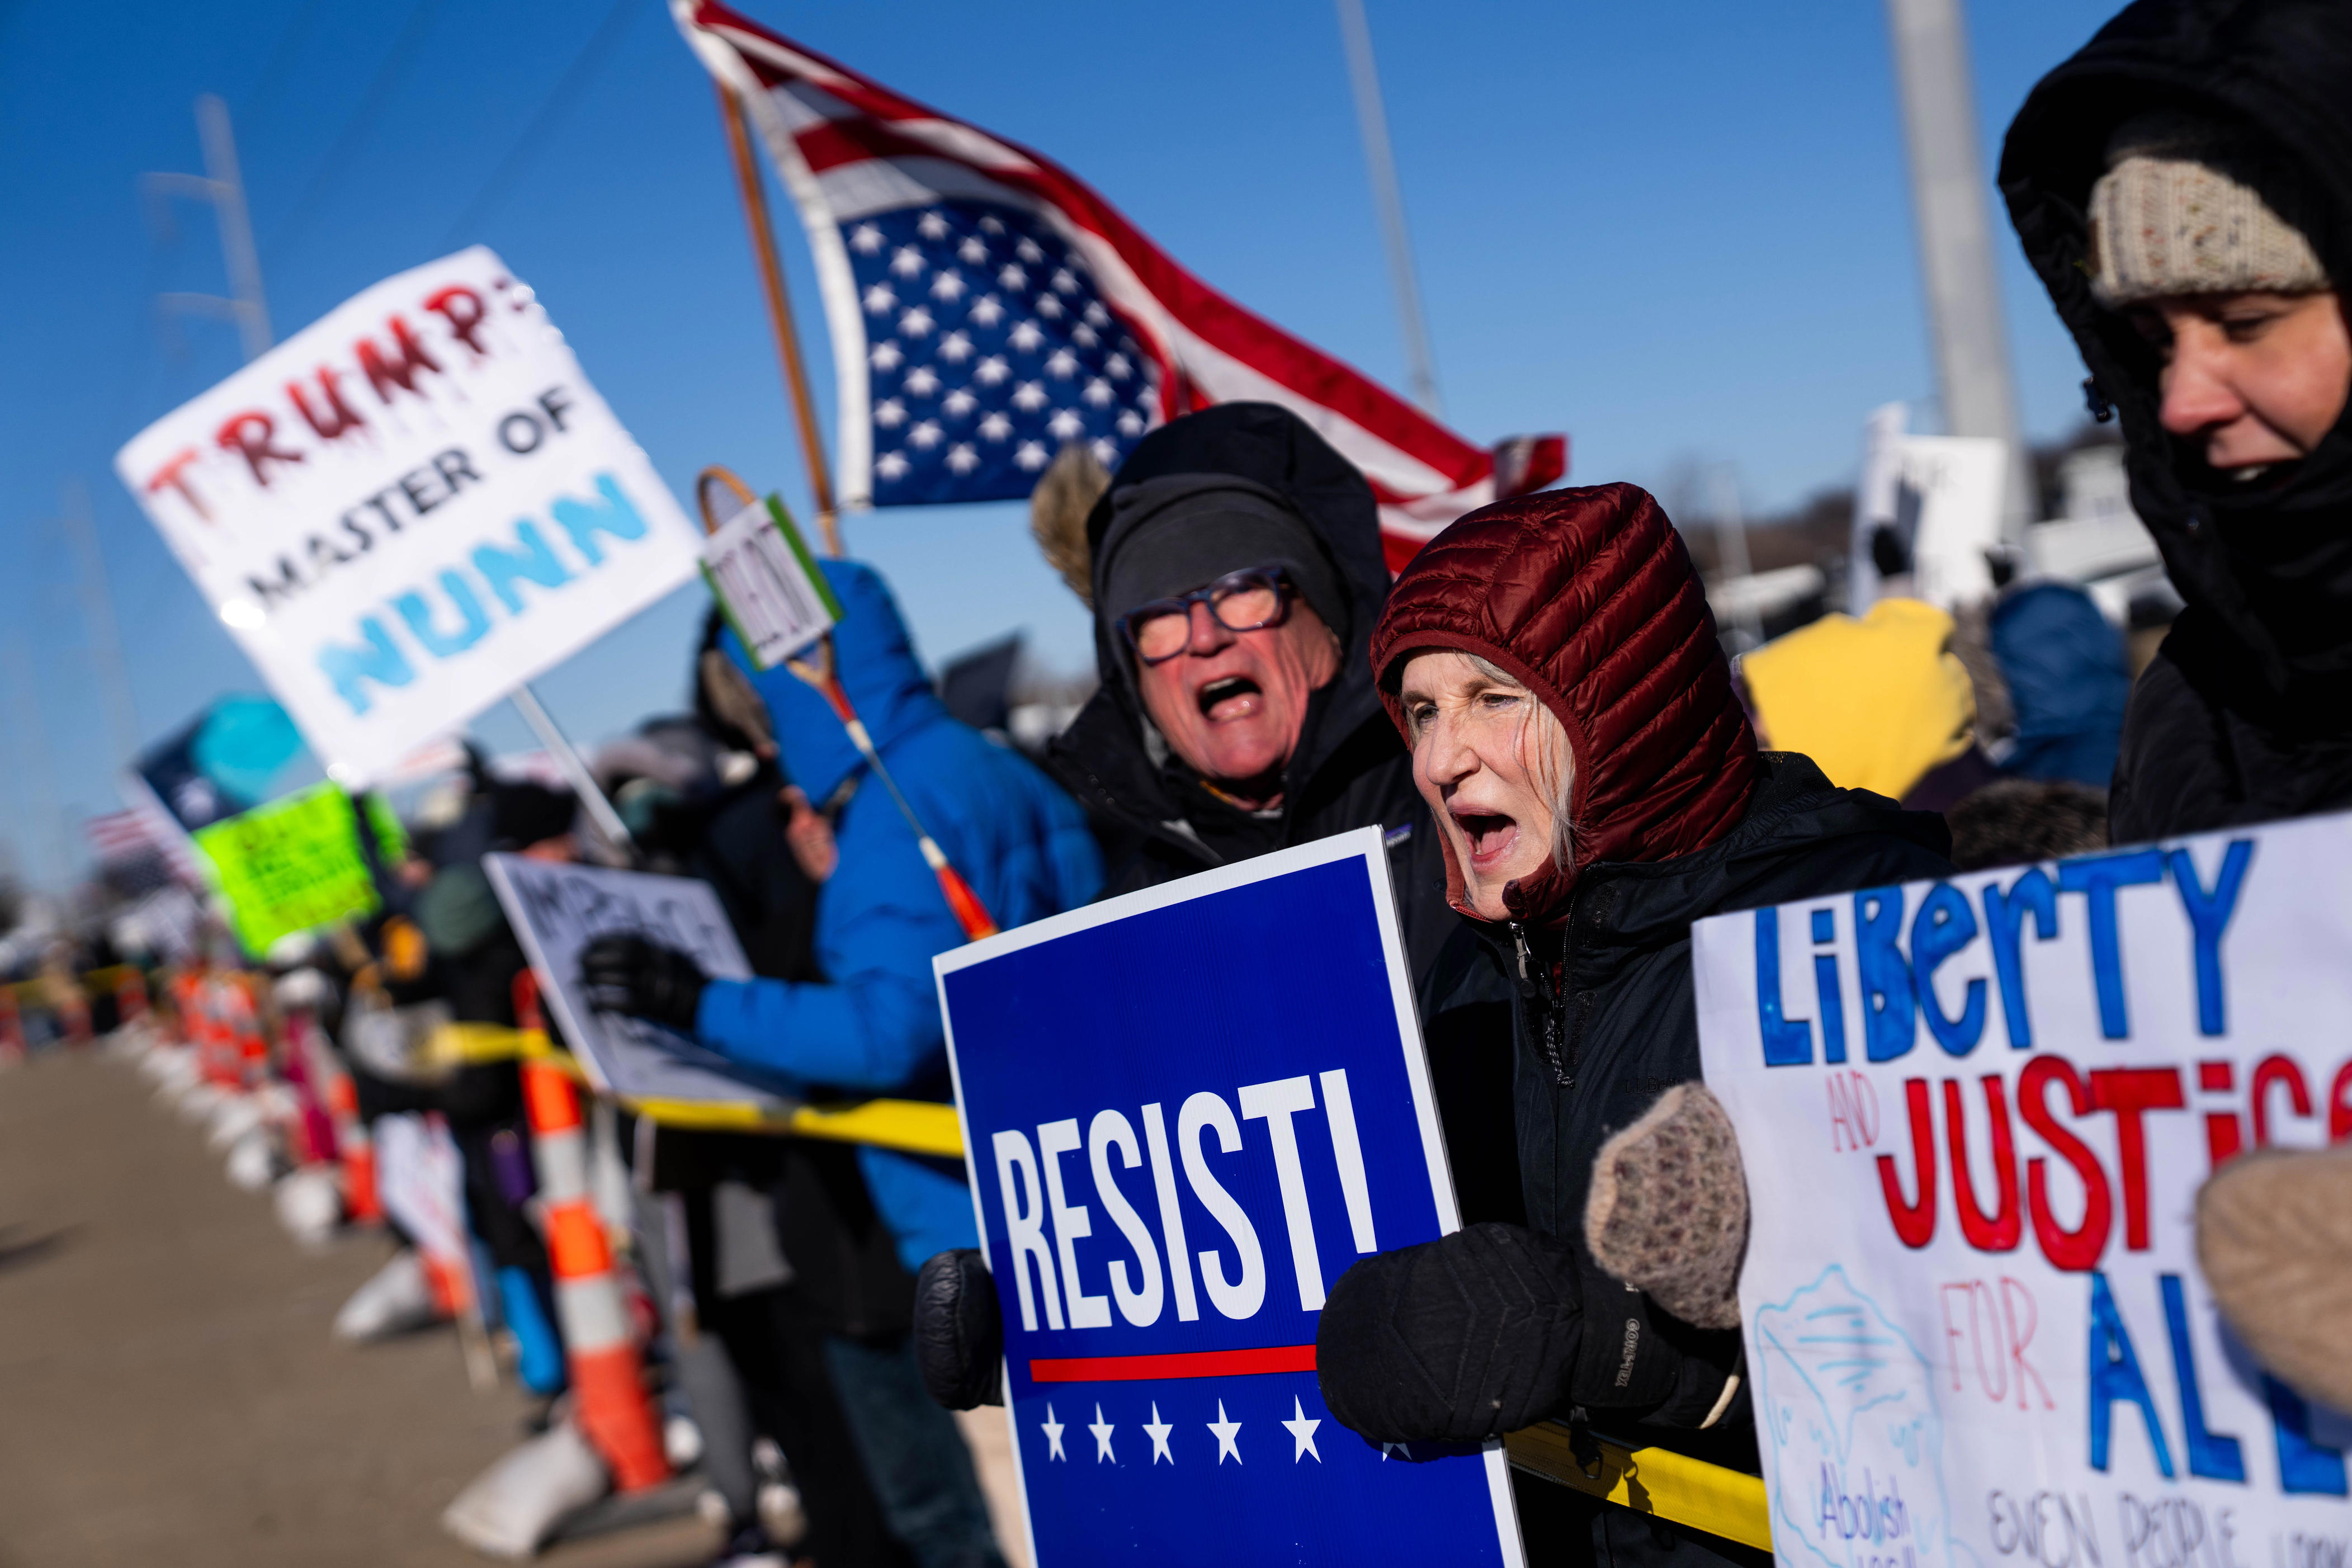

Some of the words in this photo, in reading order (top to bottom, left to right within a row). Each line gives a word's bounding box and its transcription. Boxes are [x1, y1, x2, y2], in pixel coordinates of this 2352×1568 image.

[247, 447, 482, 602] MASTER
[497, 384, 575, 455] OF
[317, 470, 652, 717] NUNN
[1826, 1070, 1881, 1152] AND
[991, 1068, 1377, 1331] RESIST!
[1615, 1317, 1640, 1387] GORE-TEX
[1940, 1277, 2057, 1410] FOR
[1820, 1460, 1911, 1541] Abolish
[1986, 1487, 2104, 1568] EVEN
